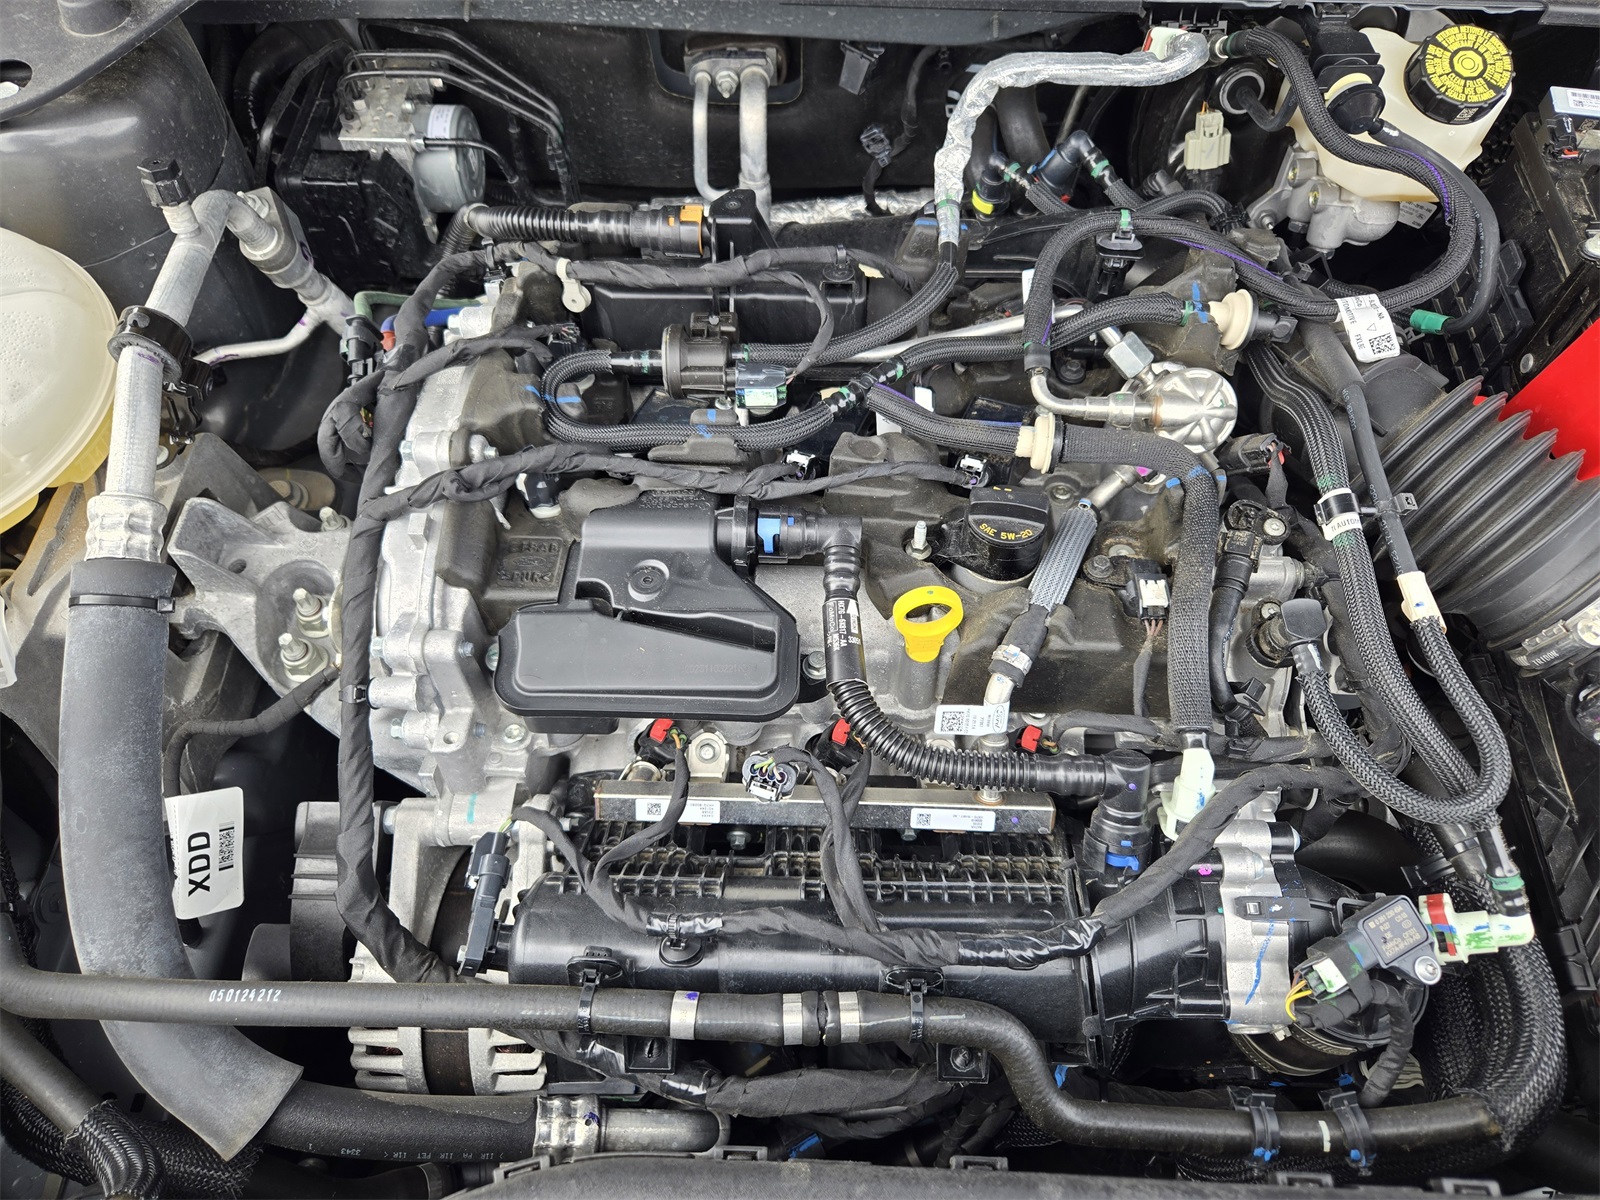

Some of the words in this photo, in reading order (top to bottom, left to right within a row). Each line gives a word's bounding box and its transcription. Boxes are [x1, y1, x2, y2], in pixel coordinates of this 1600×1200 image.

[979, 523, 998, 537] SAE
[1000, 529, 1033, 540] 5W-20
[1532, 650, 1559, 666] TRIDON
[188, 831, 211, 897] XDD
[208, 988, 282, 1003] 050124212
